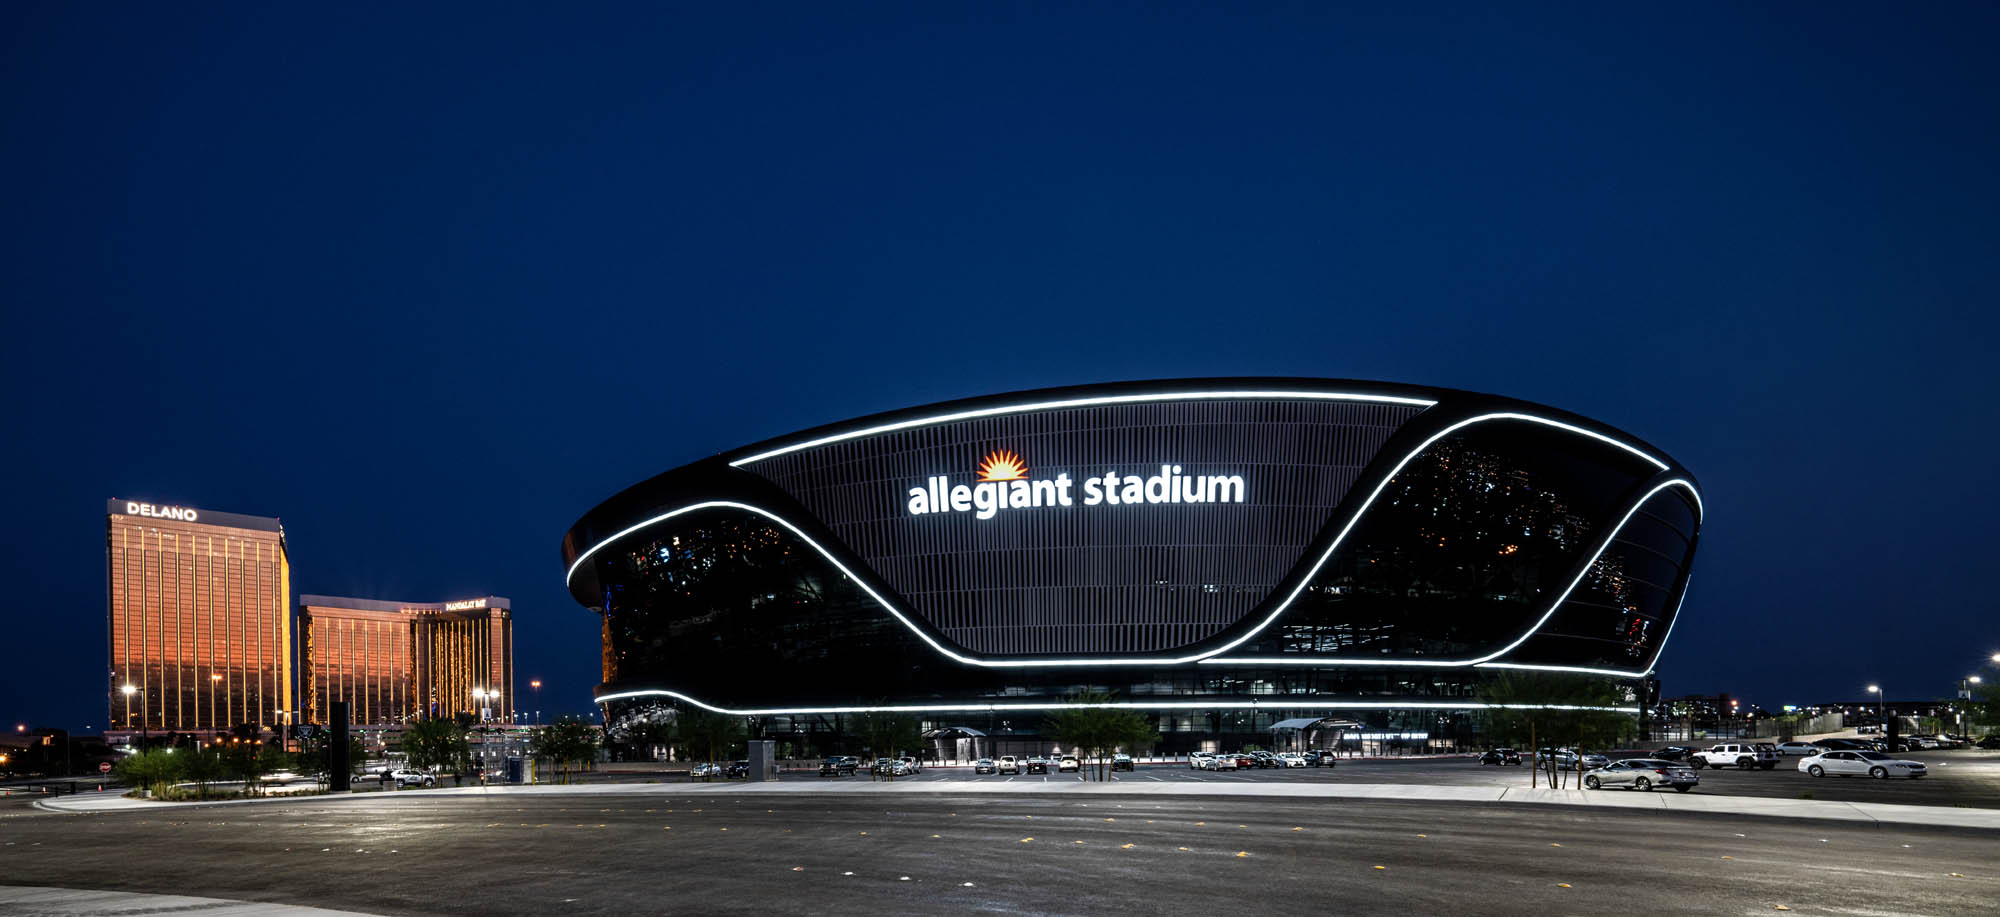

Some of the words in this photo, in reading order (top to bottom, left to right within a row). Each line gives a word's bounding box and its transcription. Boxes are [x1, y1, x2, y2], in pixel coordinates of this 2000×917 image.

[908, 472, 1073, 520] allegiant
[1083, 464, 1245, 506] stadium
[127, 502, 198, 521] DELANO
